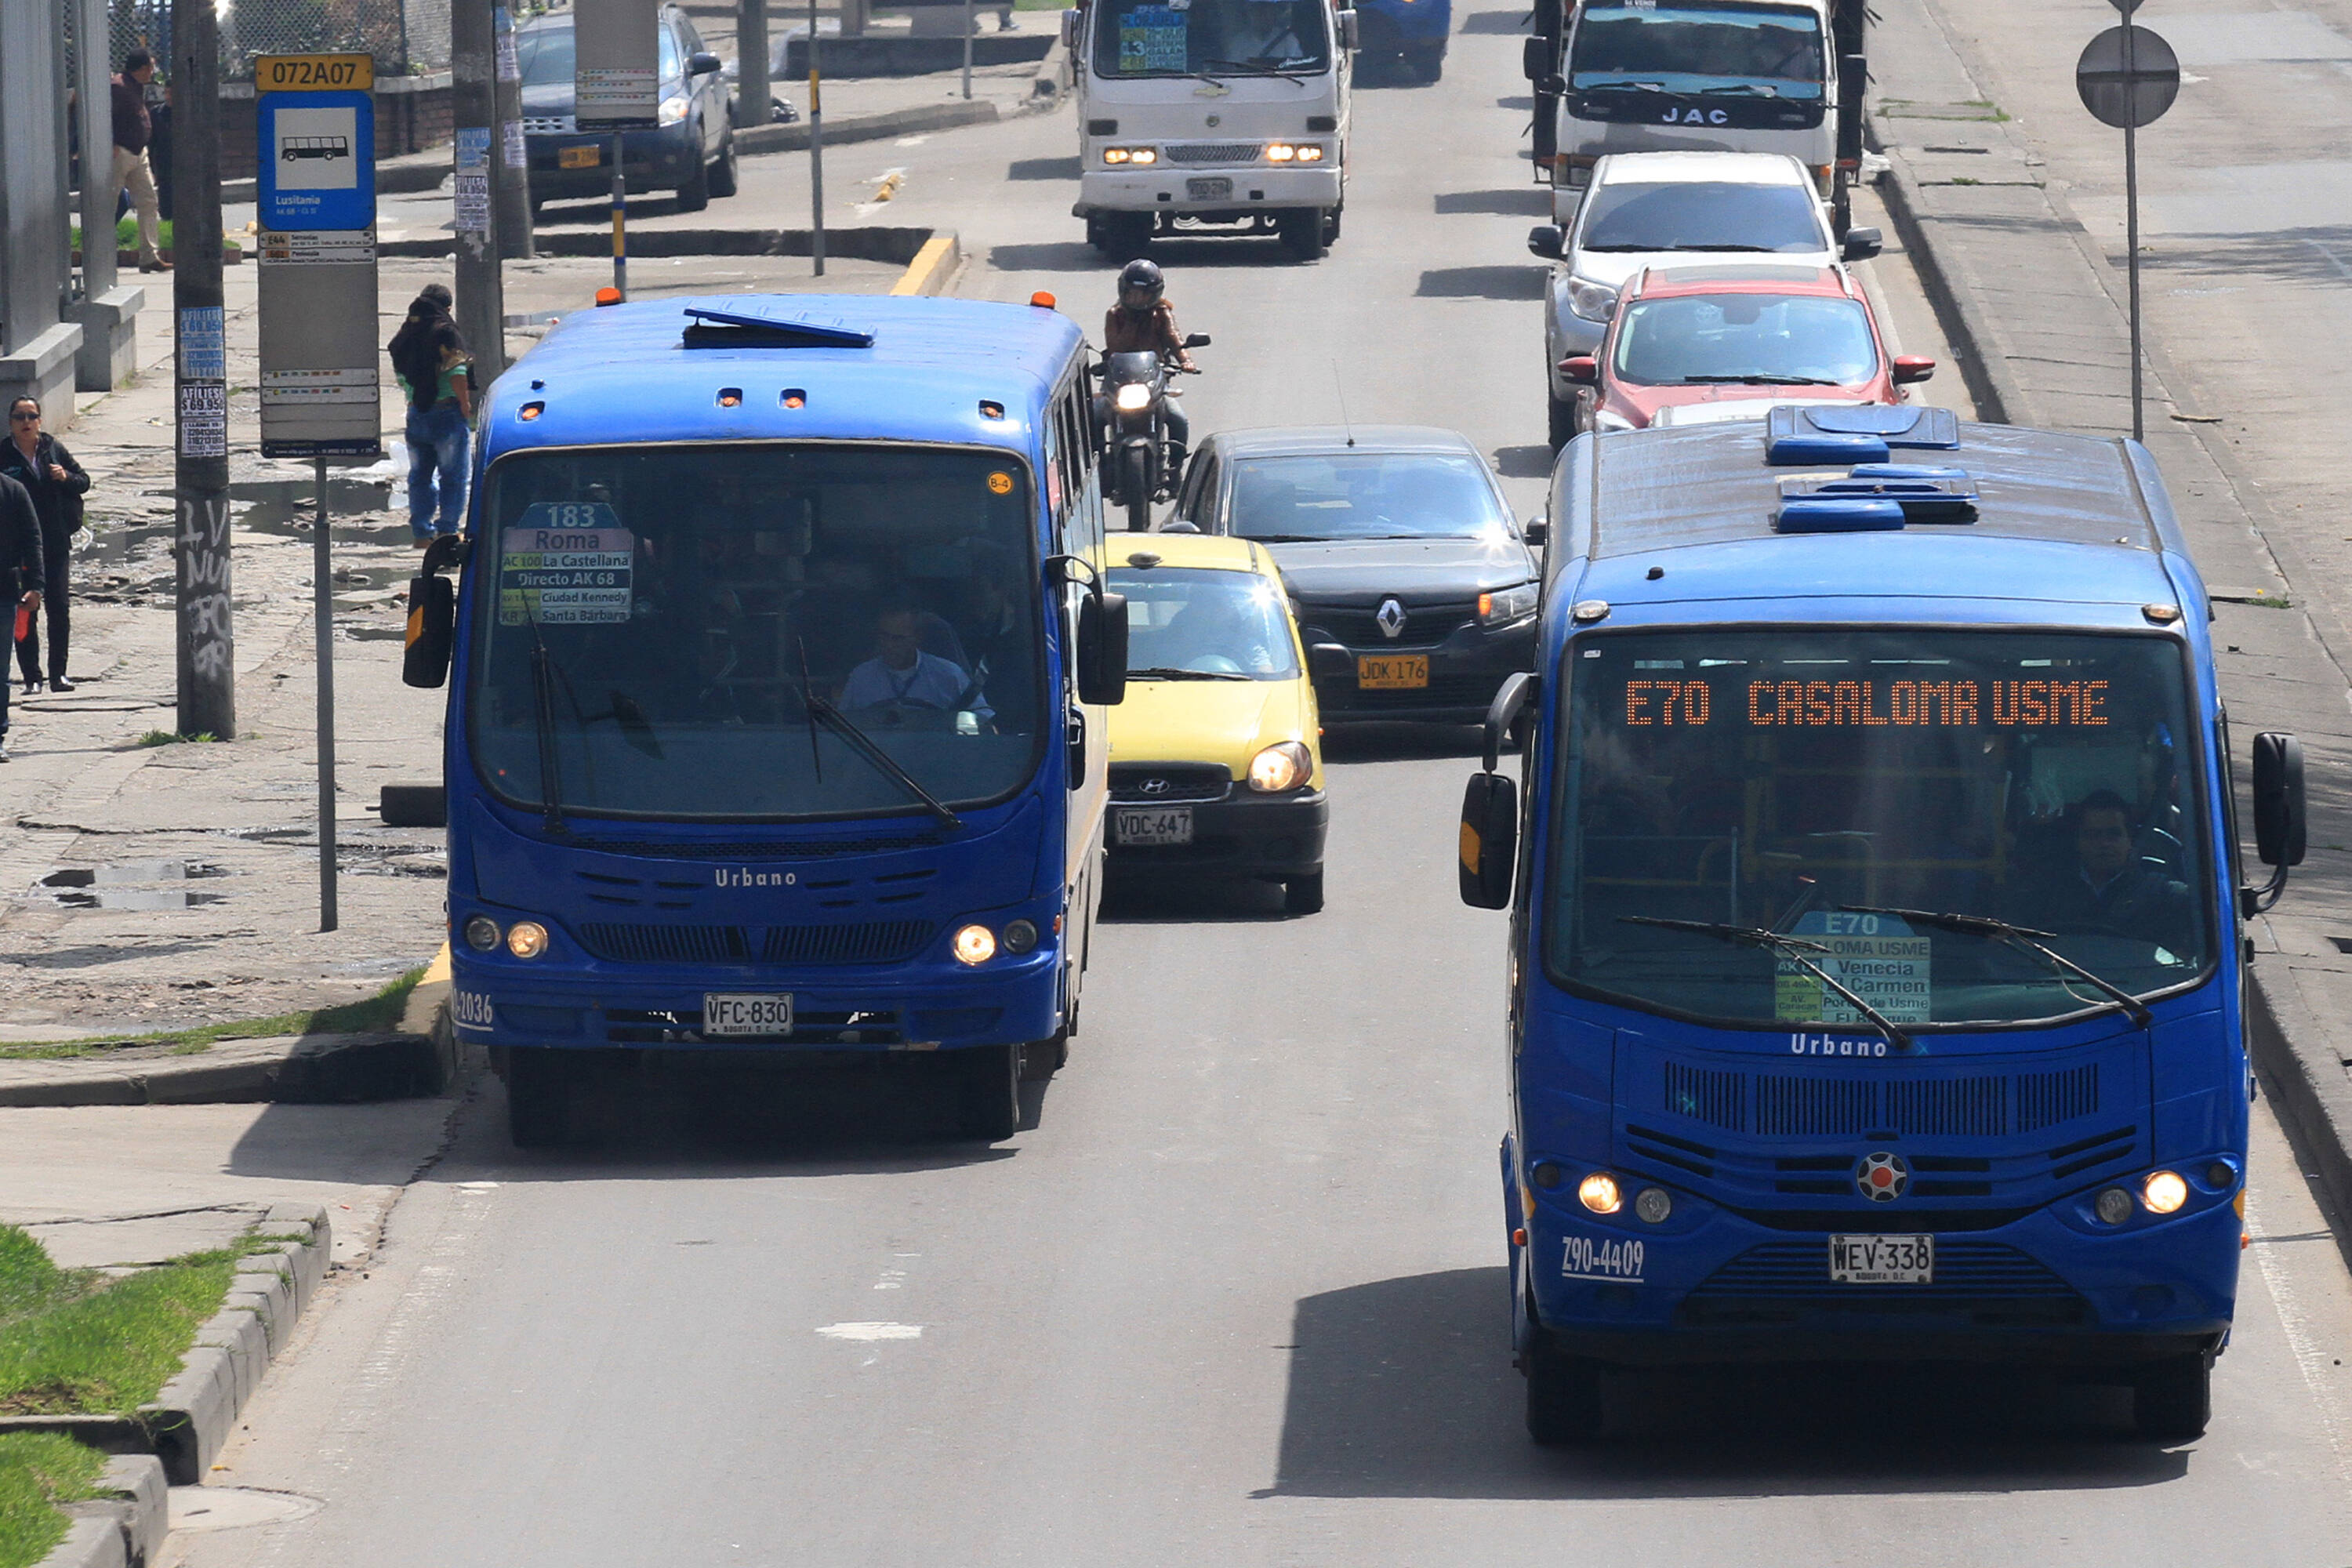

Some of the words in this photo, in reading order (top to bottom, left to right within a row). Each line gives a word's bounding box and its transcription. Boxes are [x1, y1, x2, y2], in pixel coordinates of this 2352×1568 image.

[273, 62, 357, 84] 072A07
[1662, 107, 1728, 124] JAC
[276, 194, 321, 205] Lusitania
[990, 478, 1009, 488] B-4
[548, 505, 596, 528] 183
[535, 530, 600, 549] Roma
[504, 557, 519, 566] AC
[522, 557, 541, 566] 100
[543, 556, 557, 567] La
[561, 554, 629, 567] Castellana
[518, 572, 569, 586] Directo
[572, 573, 593, 585] AK
[597, 572, 615, 585] 68
[542, 593, 579, 603] Ciudad
[581, 593, 627, 604] Kennedy
[502, 611, 518, 622] KR
[543, 610, 577, 622] Santa
[1626, 680, 1710, 725] E70
[1748, 680, 1978, 725] CASALOMA
[1992, 680, 2109, 725] USME
[1119, 815, 1189, 835] VDC-647
[715, 867, 797, 887] Urbano
[1826, 913, 1879, 935] E70
[1878, 942, 1929, 956] USME
[1777, 961, 1798, 972] AK
[1838, 960, 1914, 975] Venecia
[1851, 977, 1926, 993] Carmen
[1889, 997, 1929, 1008] Usme
[708, 1000, 789, 1024] VFC-830
[1791, 1033, 1886, 1057] Urbano
[1562, 1236, 1644, 1276] Z90-4409
